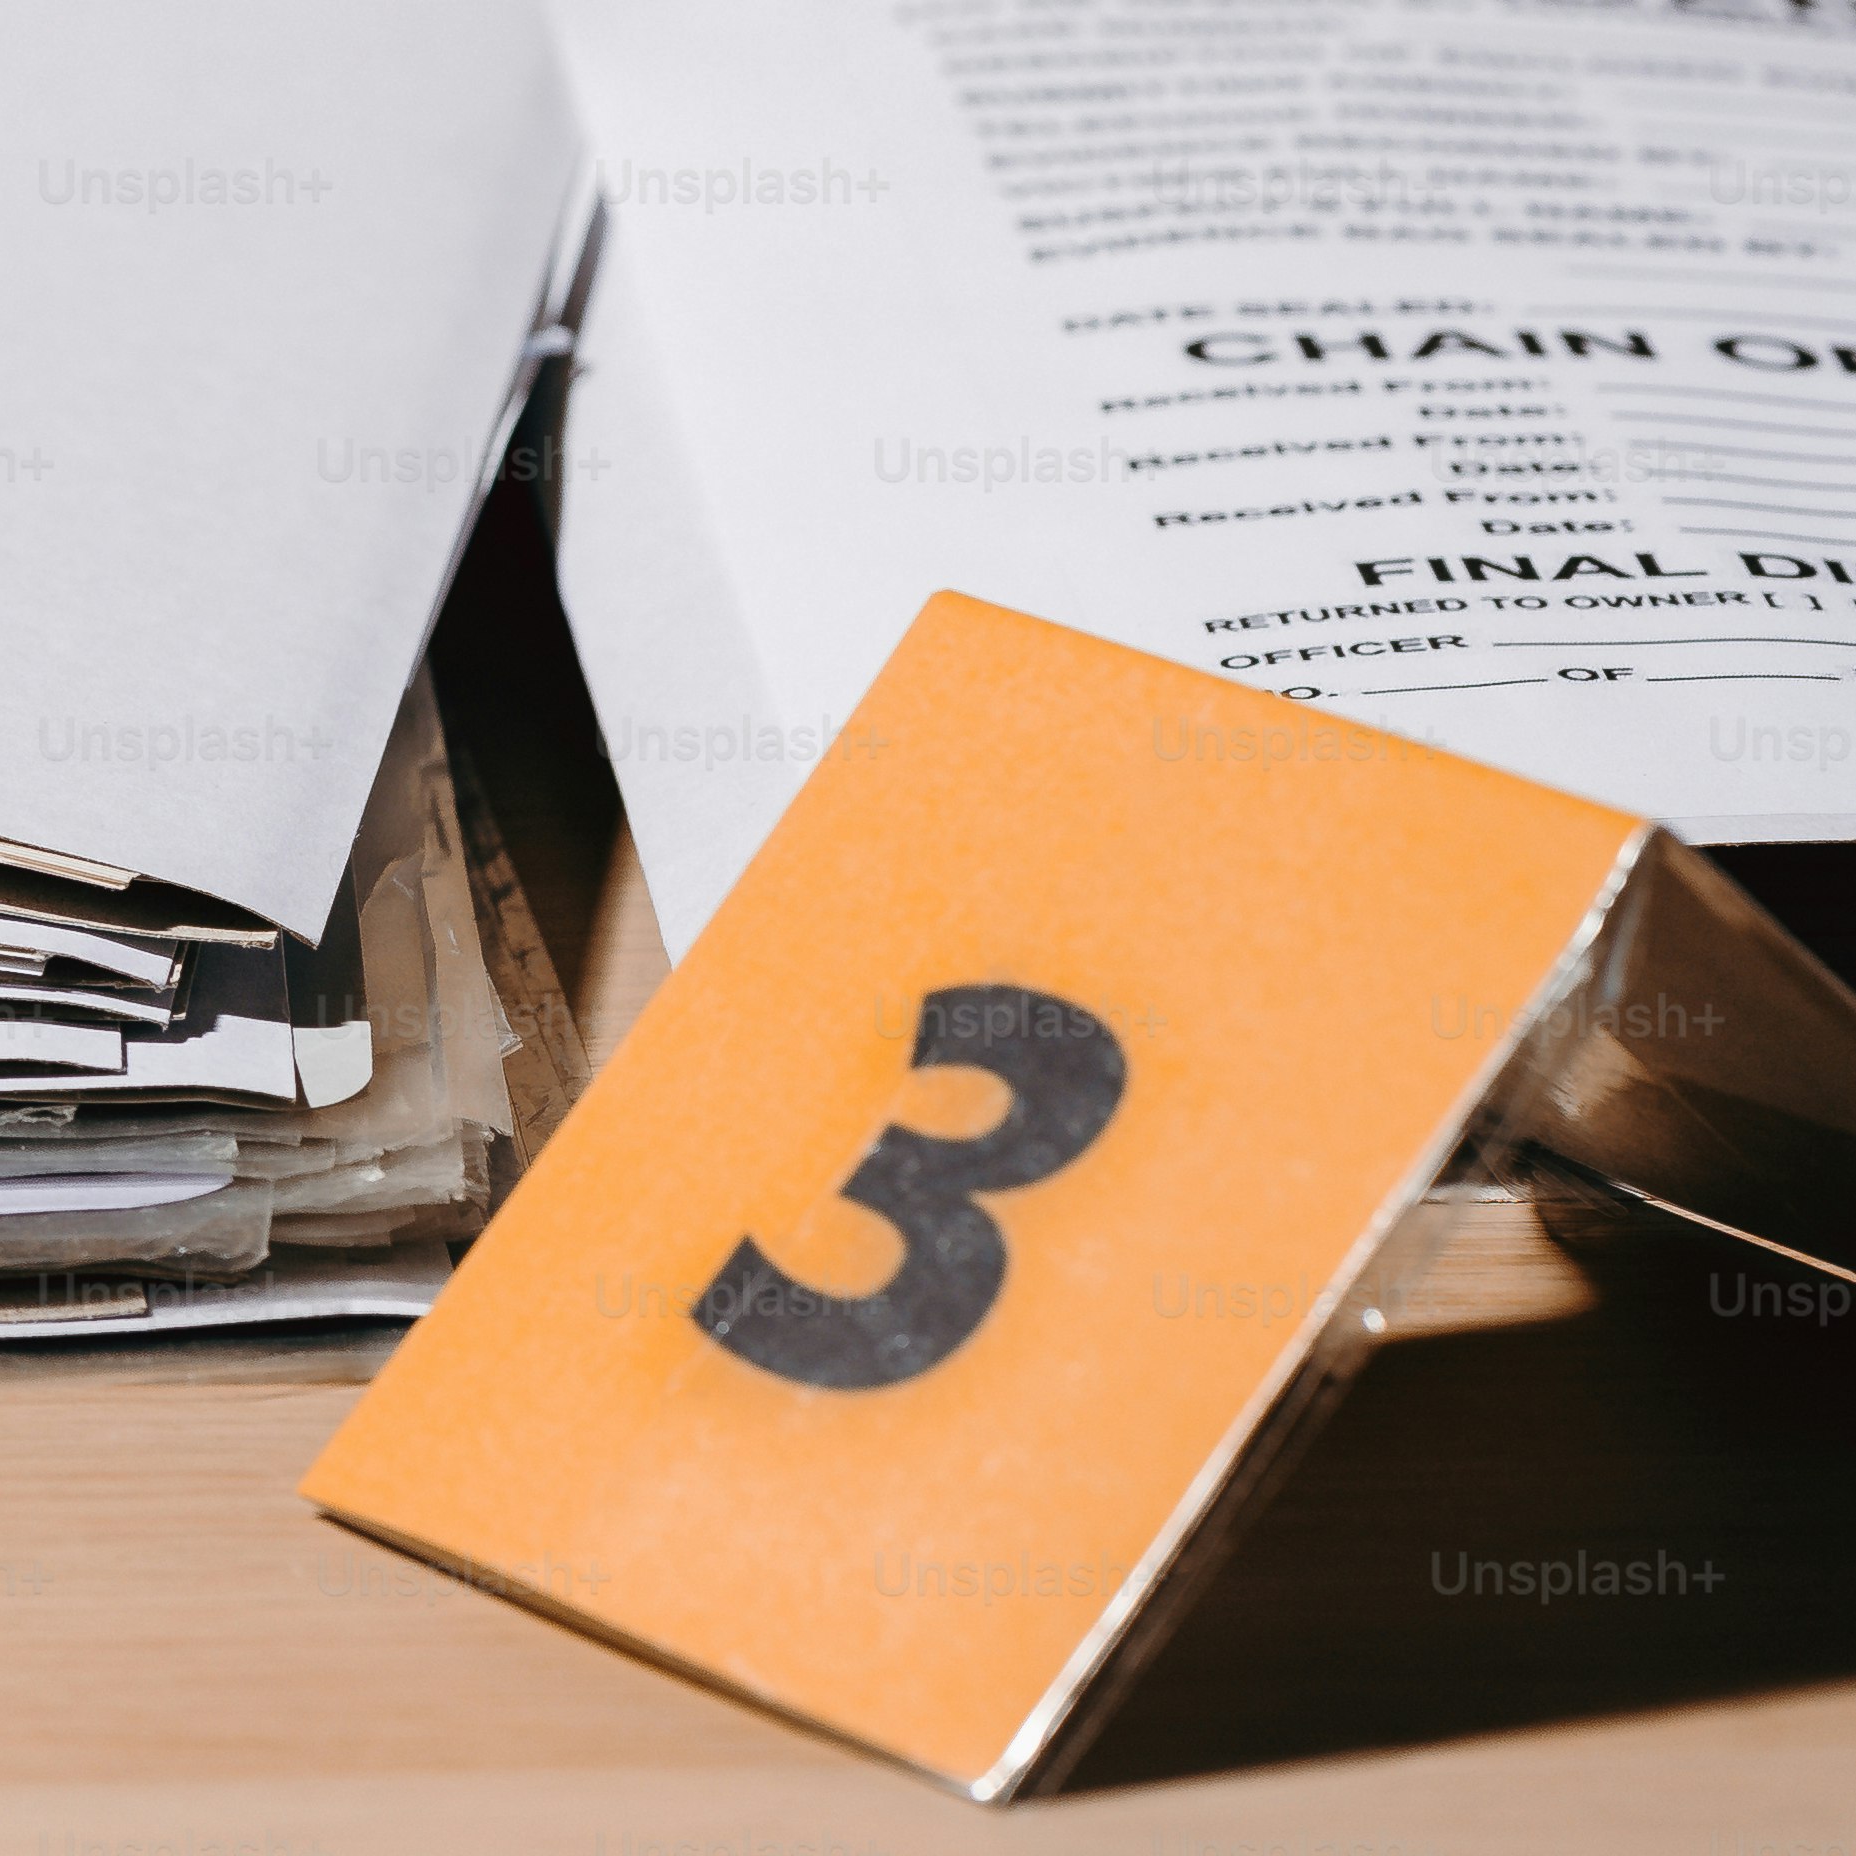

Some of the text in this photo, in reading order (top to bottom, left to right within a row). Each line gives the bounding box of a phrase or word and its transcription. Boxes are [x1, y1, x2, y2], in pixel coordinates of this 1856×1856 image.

[1183, 327, 1660, 366] CHAIN
[1098, 375, 1551, 414] Received From:
[1417, 401, 1566, 423] Date:
[1127, 429, 1584, 472] Received From:
[1446, 457, 1602, 480] Date:
[1151, 486, 1617, 527] Received From:
[1479, 516, 1635, 538] Date:
[1354, 548, 1711, 586] FINAL
[1202, 597, 1469, 634] RETURNED
[1480, 594, 1549, 611] TO
[1563, 590, 1752, 611] OWNER
[1218, 634, 1471, 670] OFFICER
[1556, 666, 1635, 683] OF
[692, 983, 1128, 1395] 3
